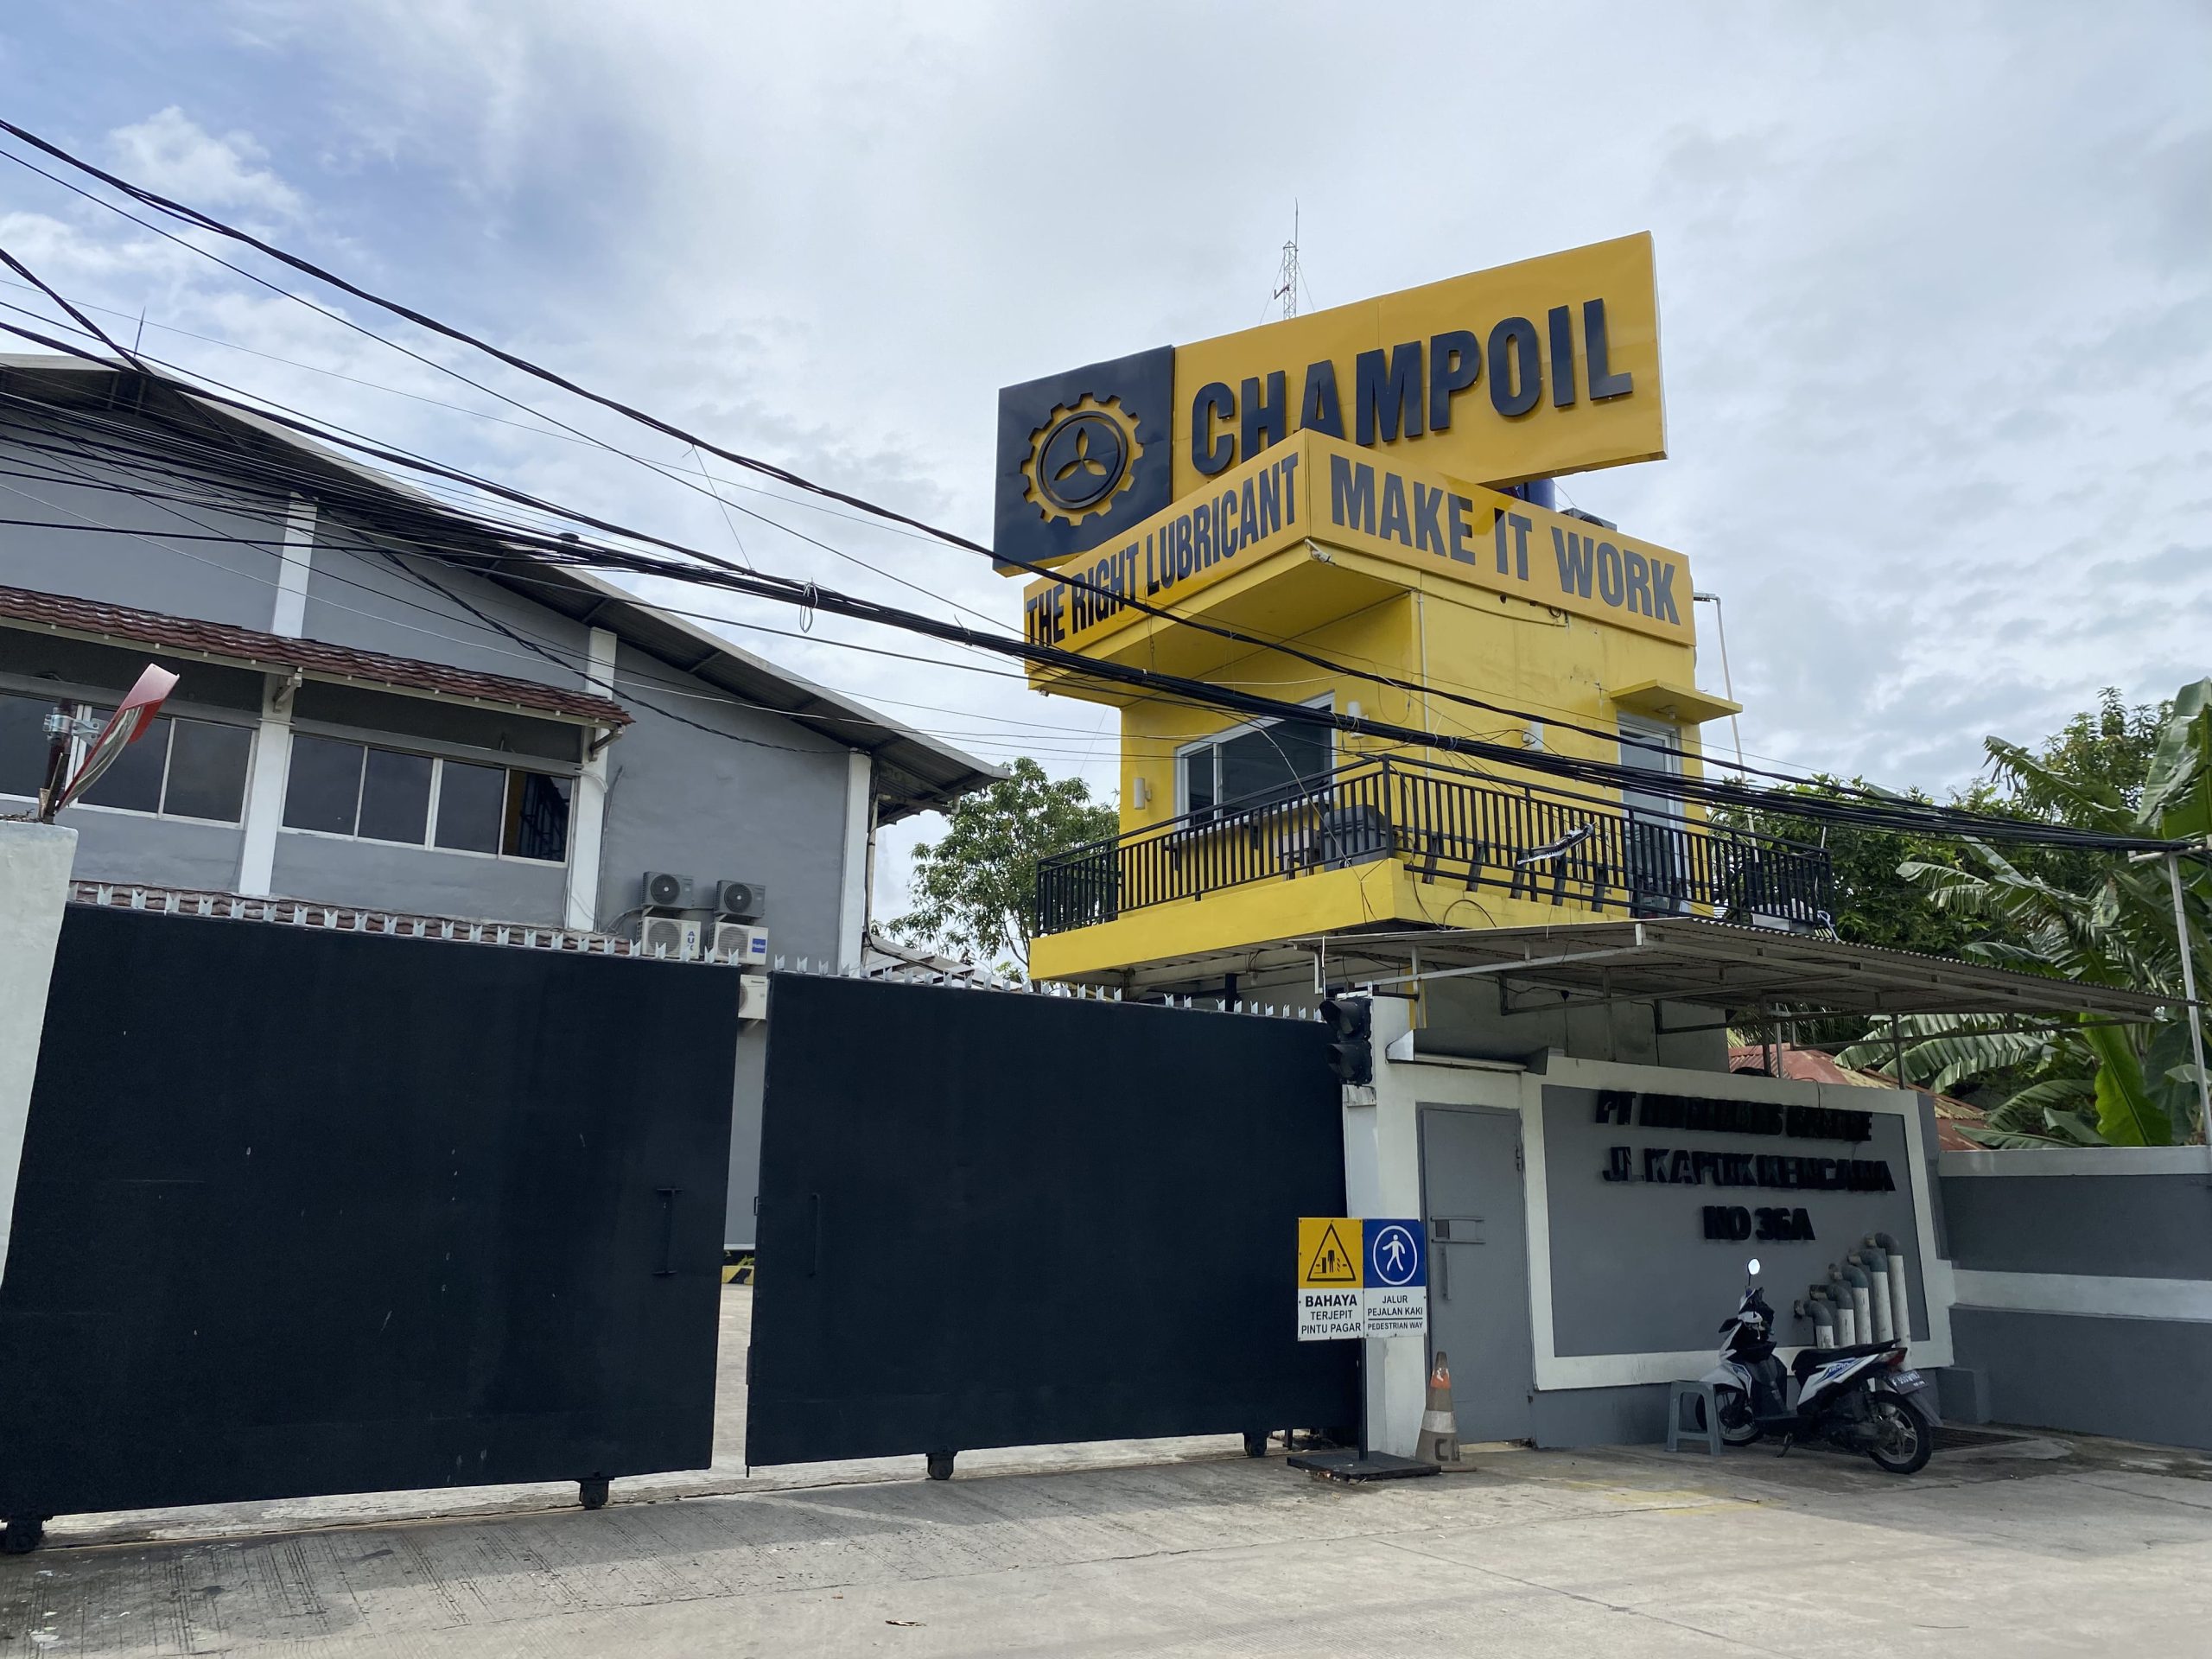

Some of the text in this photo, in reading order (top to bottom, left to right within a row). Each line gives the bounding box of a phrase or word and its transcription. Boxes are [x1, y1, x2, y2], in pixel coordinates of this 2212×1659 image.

[1192, 298, 1633, 476] CHAMPOIL
[1330, 454, 1681, 626] MAKE IT WORK
[1027, 452, 1299, 650] THE RIGHT LUBRICANT
[1305, 1294, 1357, 1307] BAHAYA
[1382, 1295, 1408, 1304] JALUR
[1310, 1310, 1353, 1320] TERJEPIT
[1367, 1306, 1423, 1316] PEJALAN KAKI
[1301, 1322, 1361, 1334] PINTU PAGAR
[1367, 1322, 1408, 1331] PEDESTRIAN
